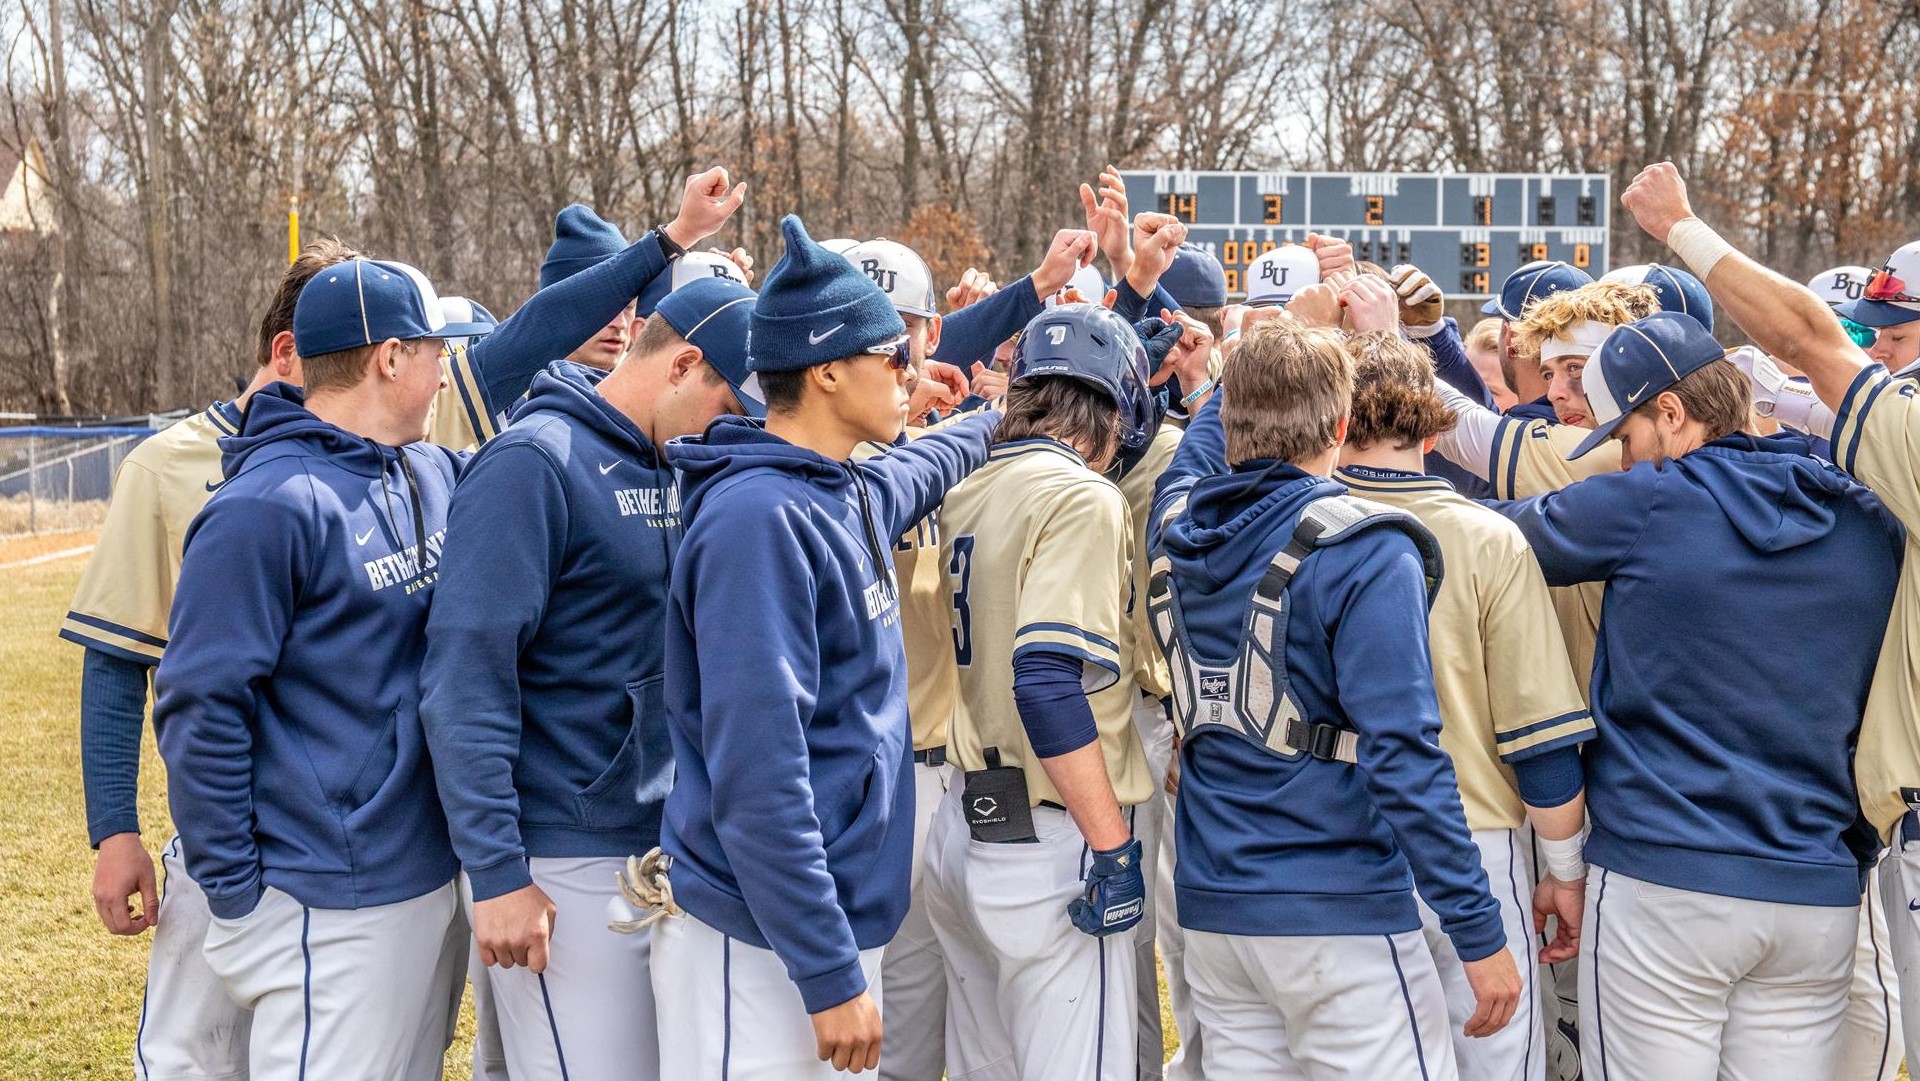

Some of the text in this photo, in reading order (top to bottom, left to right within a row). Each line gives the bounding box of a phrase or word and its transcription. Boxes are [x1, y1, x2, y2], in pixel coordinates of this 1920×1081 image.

[1350, 175, 1399, 196] STRIKE
[1169, 193, 1197, 224] 14
[1263, 194, 1283, 225] 3
[1365, 195, 1385, 226] 2
[1484, 196, 1492, 227] 1
[1223, 240, 1239, 265] 0
[1242, 240, 1258, 265] 0
[1474, 242, 1491, 268] 3
[1573, 242, 1590, 268] 0
[861, 258, 898, 293] BU
[1260, 259, 1289, 287] BU
[1473, 271, 1491, 294] 4
[1831, 272, 1865, 300] BU
[971, 816, 1007, 825] EVOSHIELD
